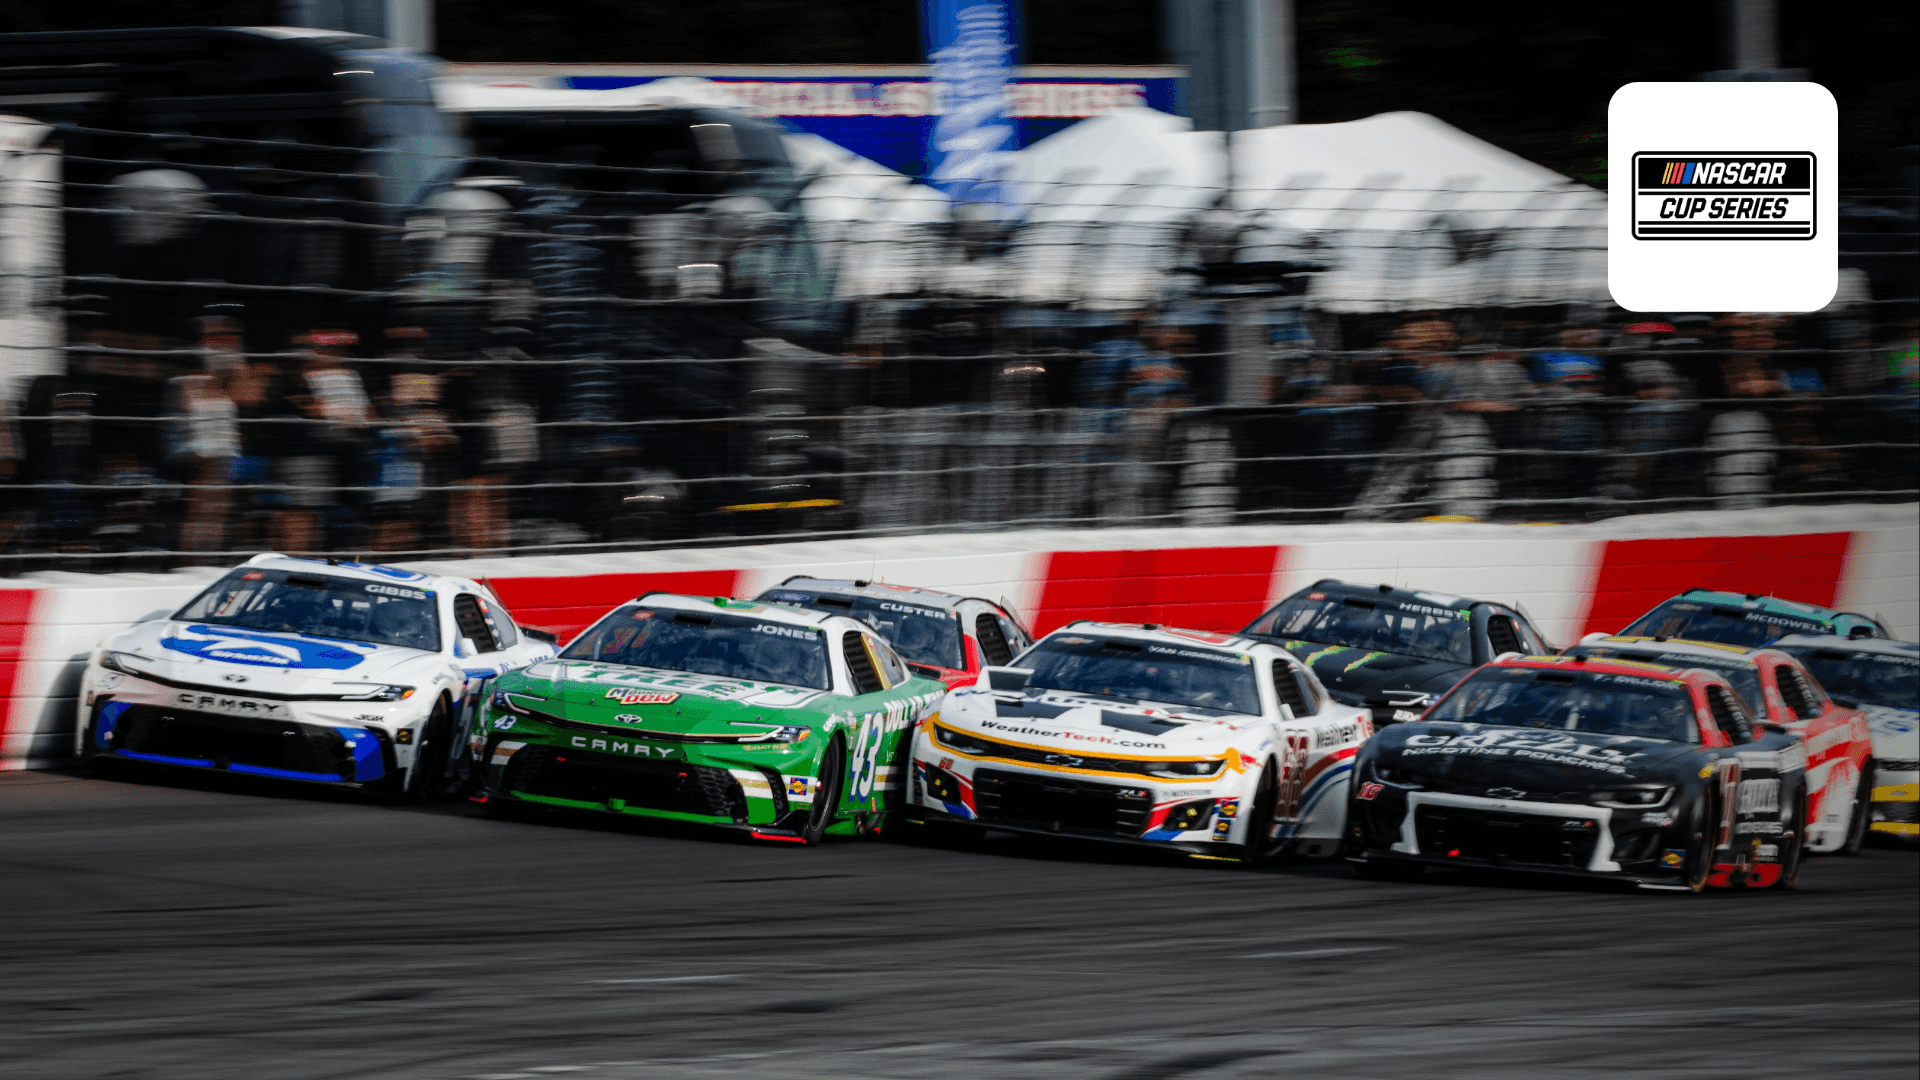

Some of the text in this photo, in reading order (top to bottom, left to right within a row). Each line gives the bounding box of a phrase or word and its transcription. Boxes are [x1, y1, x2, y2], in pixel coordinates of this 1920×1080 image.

[364, 584, 428, 601] GIBBS
[879, 602, 946, 620] CUSTER
[1400, 602, 1464, 619] HERBST
[751, 624, 818, 641] JONES
[1148, 645, 1178, 655] VAN
[178, 693, 280, 712] CAMRY
[493, 714, 518, 731] 43
[981, 719, 1166, 750] WeatherTech.com
[570, 735, 675, 759] CAMRY
[849, 711, 884, 802] 43
[1402, 747, 1627, 775] NICOTINE POUCHES
[1356, 781, 1385, 800] 10
